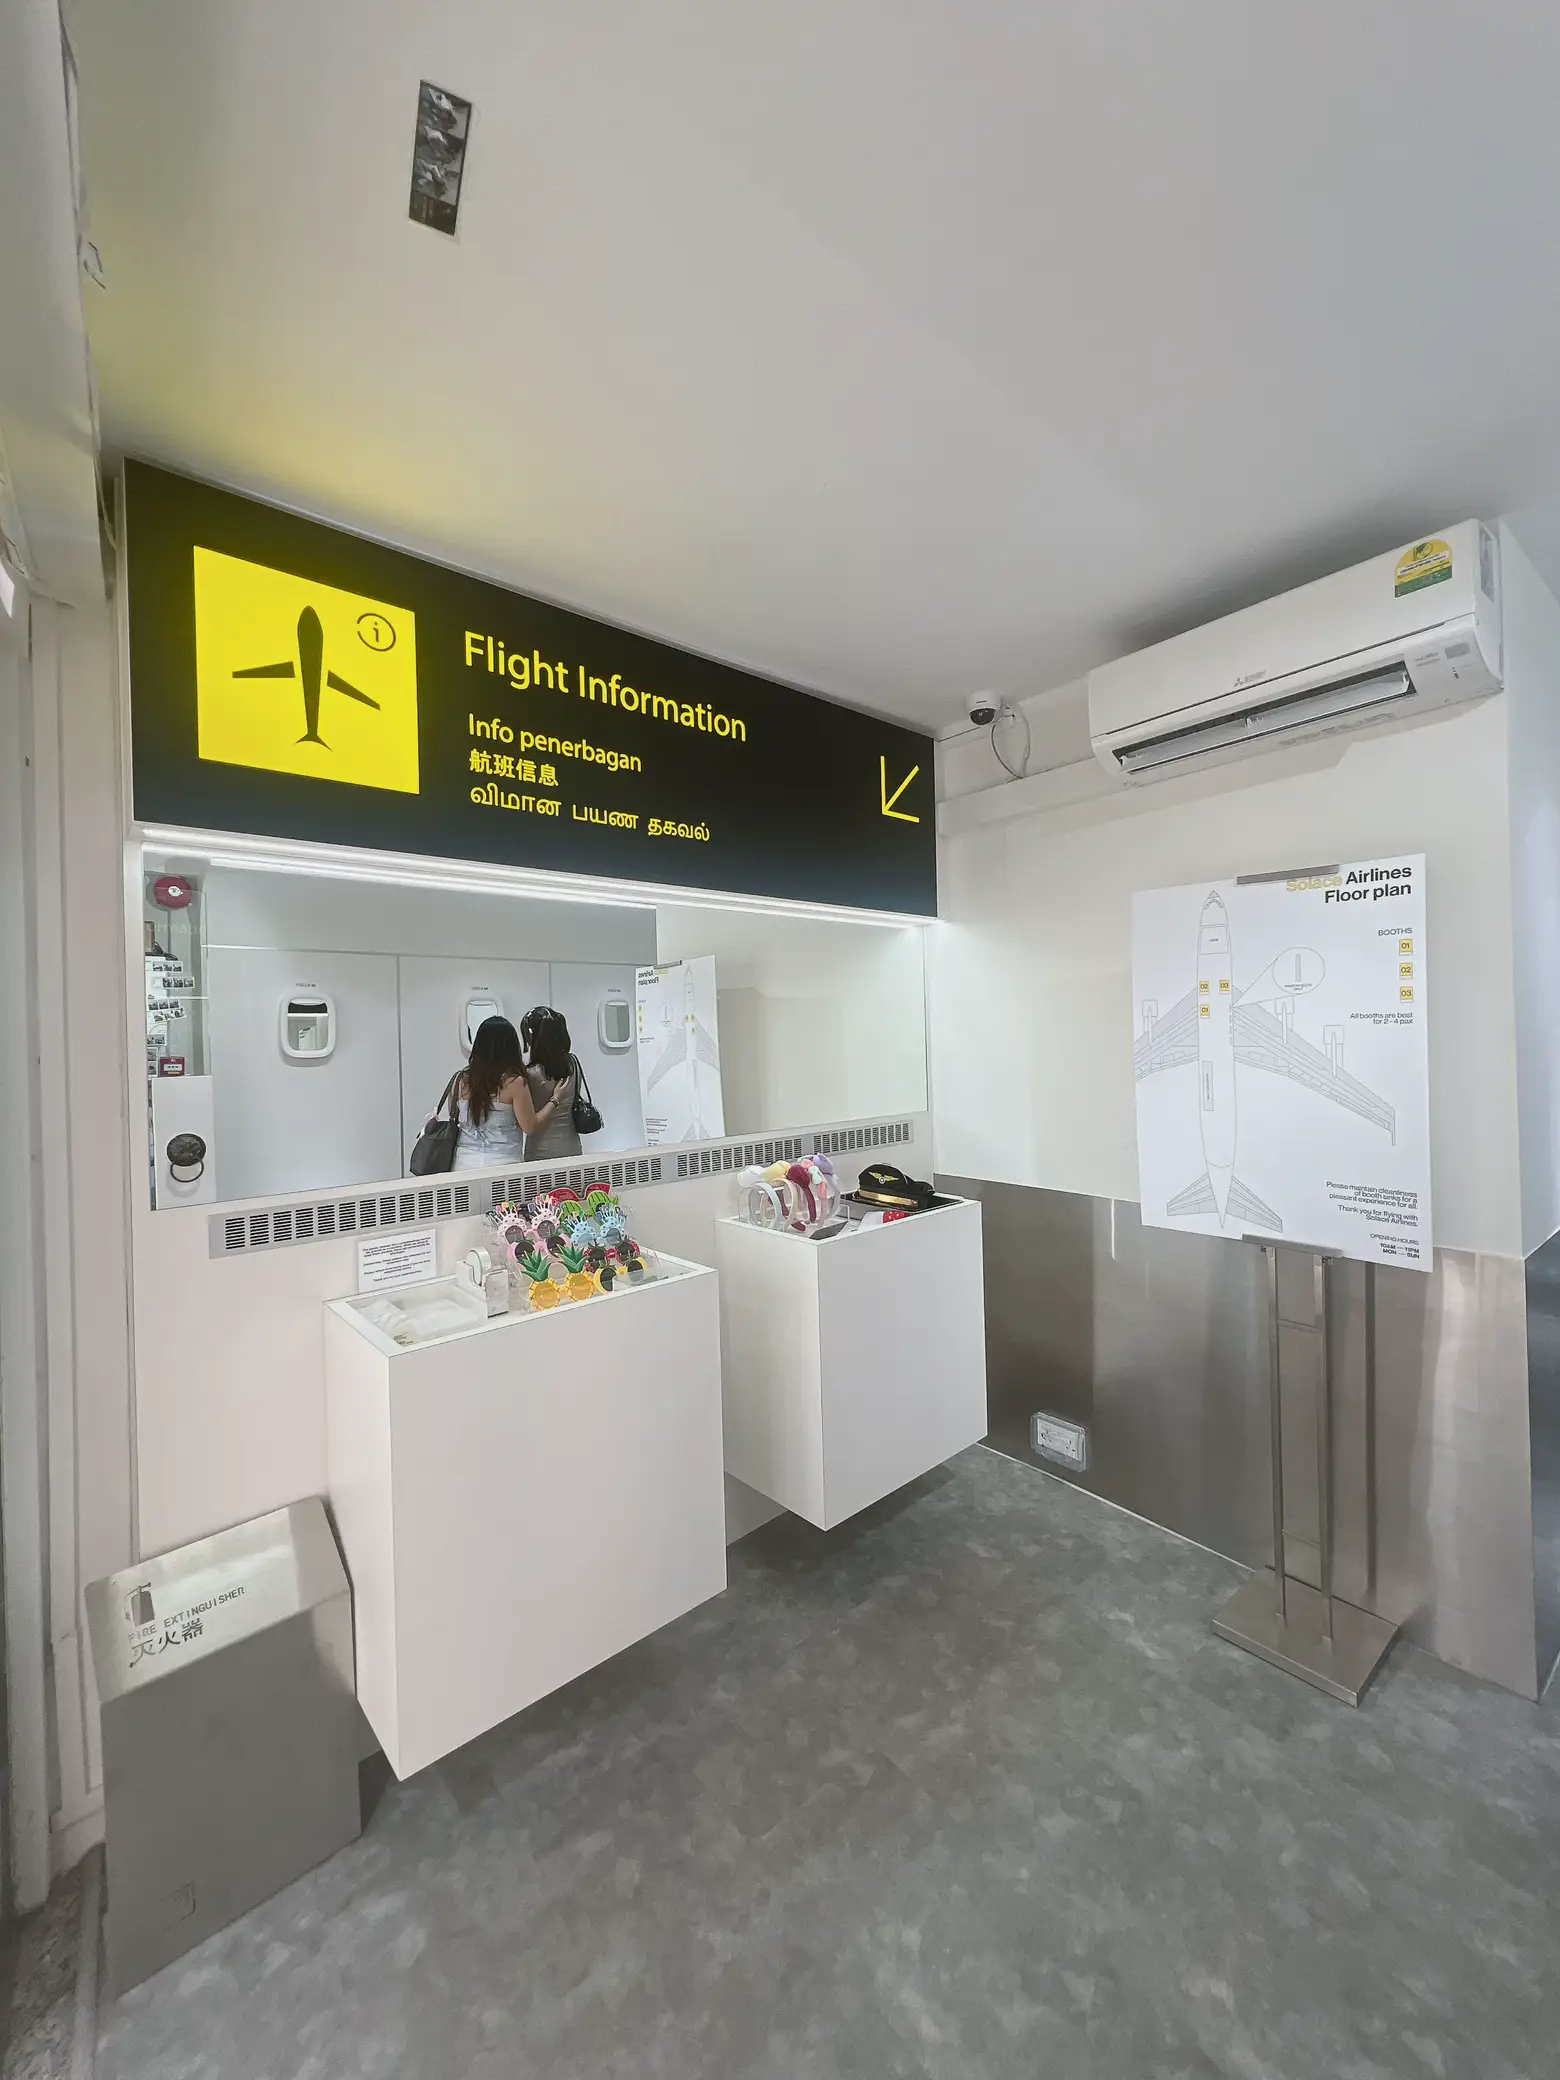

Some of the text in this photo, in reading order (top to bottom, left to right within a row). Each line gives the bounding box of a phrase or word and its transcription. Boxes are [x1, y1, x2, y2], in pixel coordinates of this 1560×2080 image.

[464, 630, 747, 742] Flight Information
[468, 713, 642, 772] Info penerbagan
[468, 748, 559, 787] 航班信息
[470, 782, 710, 842] விமான பயண தகவல்
[1286, 867, 1412, 892] Solace Airlines
[1325, 884, 1412, 904] Floor plan
[1378, 927, 1412, 936] BOOTHS
[1326, 1181, 1418, 1198] Please maintain cleanliness
[1362, 1191, 1382, 1199] booth
[1329, 1193, 1358, 1202] pleasant
[1358, 1197, 1396, 1207] experience
[1338, 1204, 1358, 1213] Thank
[1359, 1208, 1372, 1216] you
[1383, 1211, 1402, 1220] flying
[1403, 1213, 1419, 1221] with
[1366, 1214, 1390, 1223] Solace
[1370, 1233, 1420, 1246] OPENING HOURS
[127, 1586, 245, 1644] FIRE EXTINGUISHER
[128, 1618, 204, 1668] 灭火器
